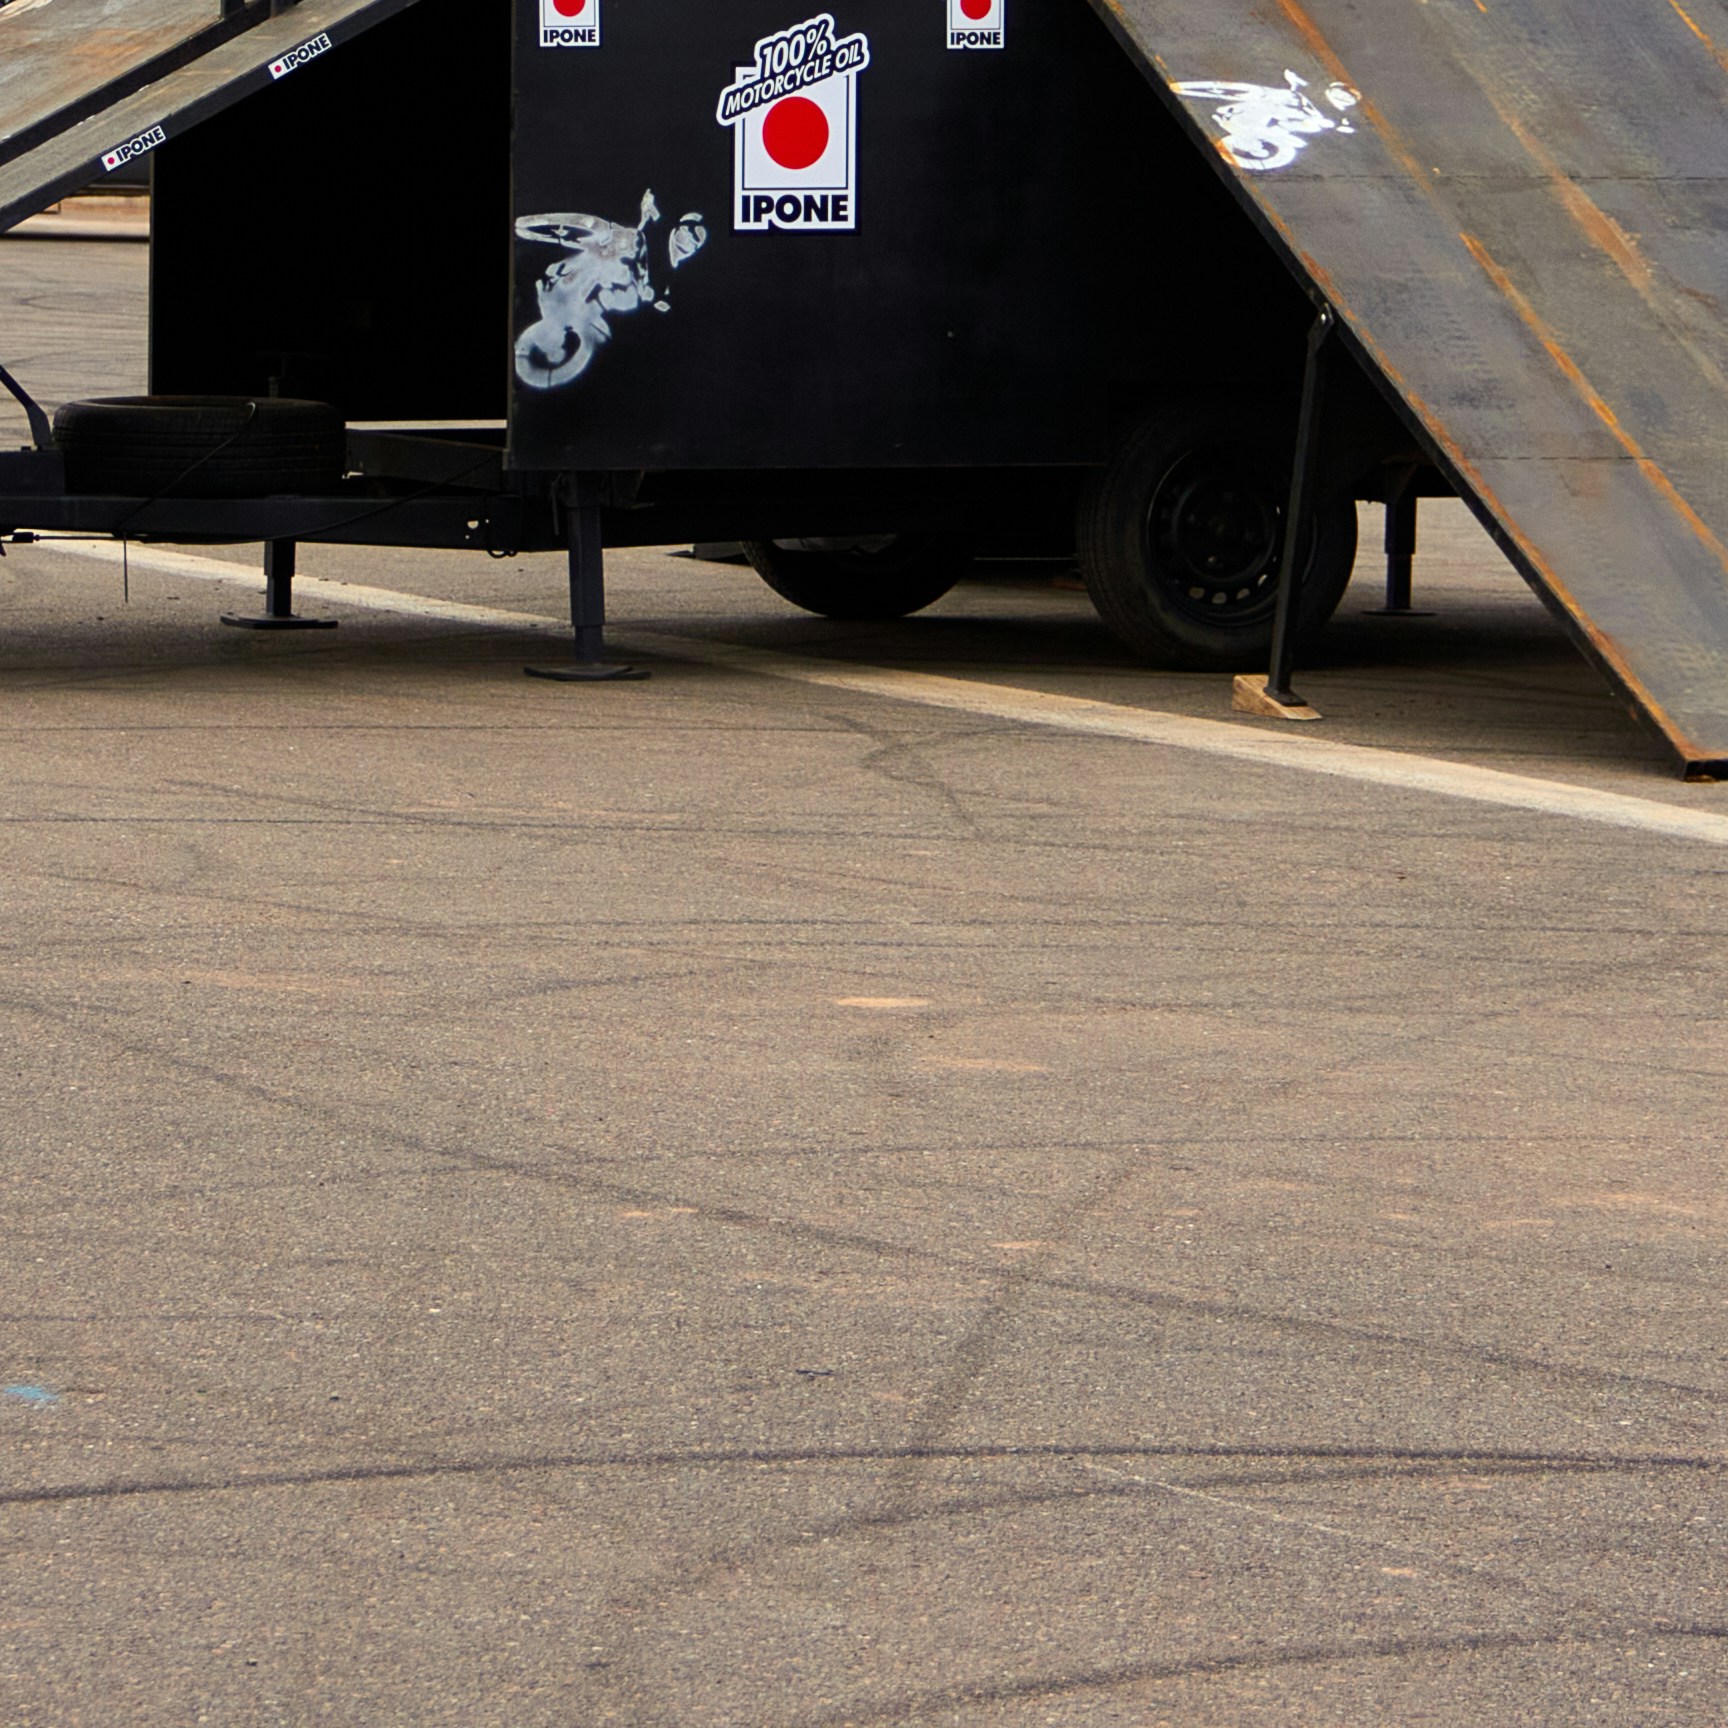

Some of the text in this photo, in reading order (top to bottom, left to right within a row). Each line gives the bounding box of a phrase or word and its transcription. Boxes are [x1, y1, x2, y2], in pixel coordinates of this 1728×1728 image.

[281, 34, 331, 70] IPONE
[543, 28, 597, 44] IPONE
[761, 23, 829, 79] 100%
[950, 30, 1001, 46] IPONE
[724, 43, 861, 117] MOTORCYCLE OIL
[115, 127, 166, 163] IPONE
[741, 193, 849, 224] IPONE
